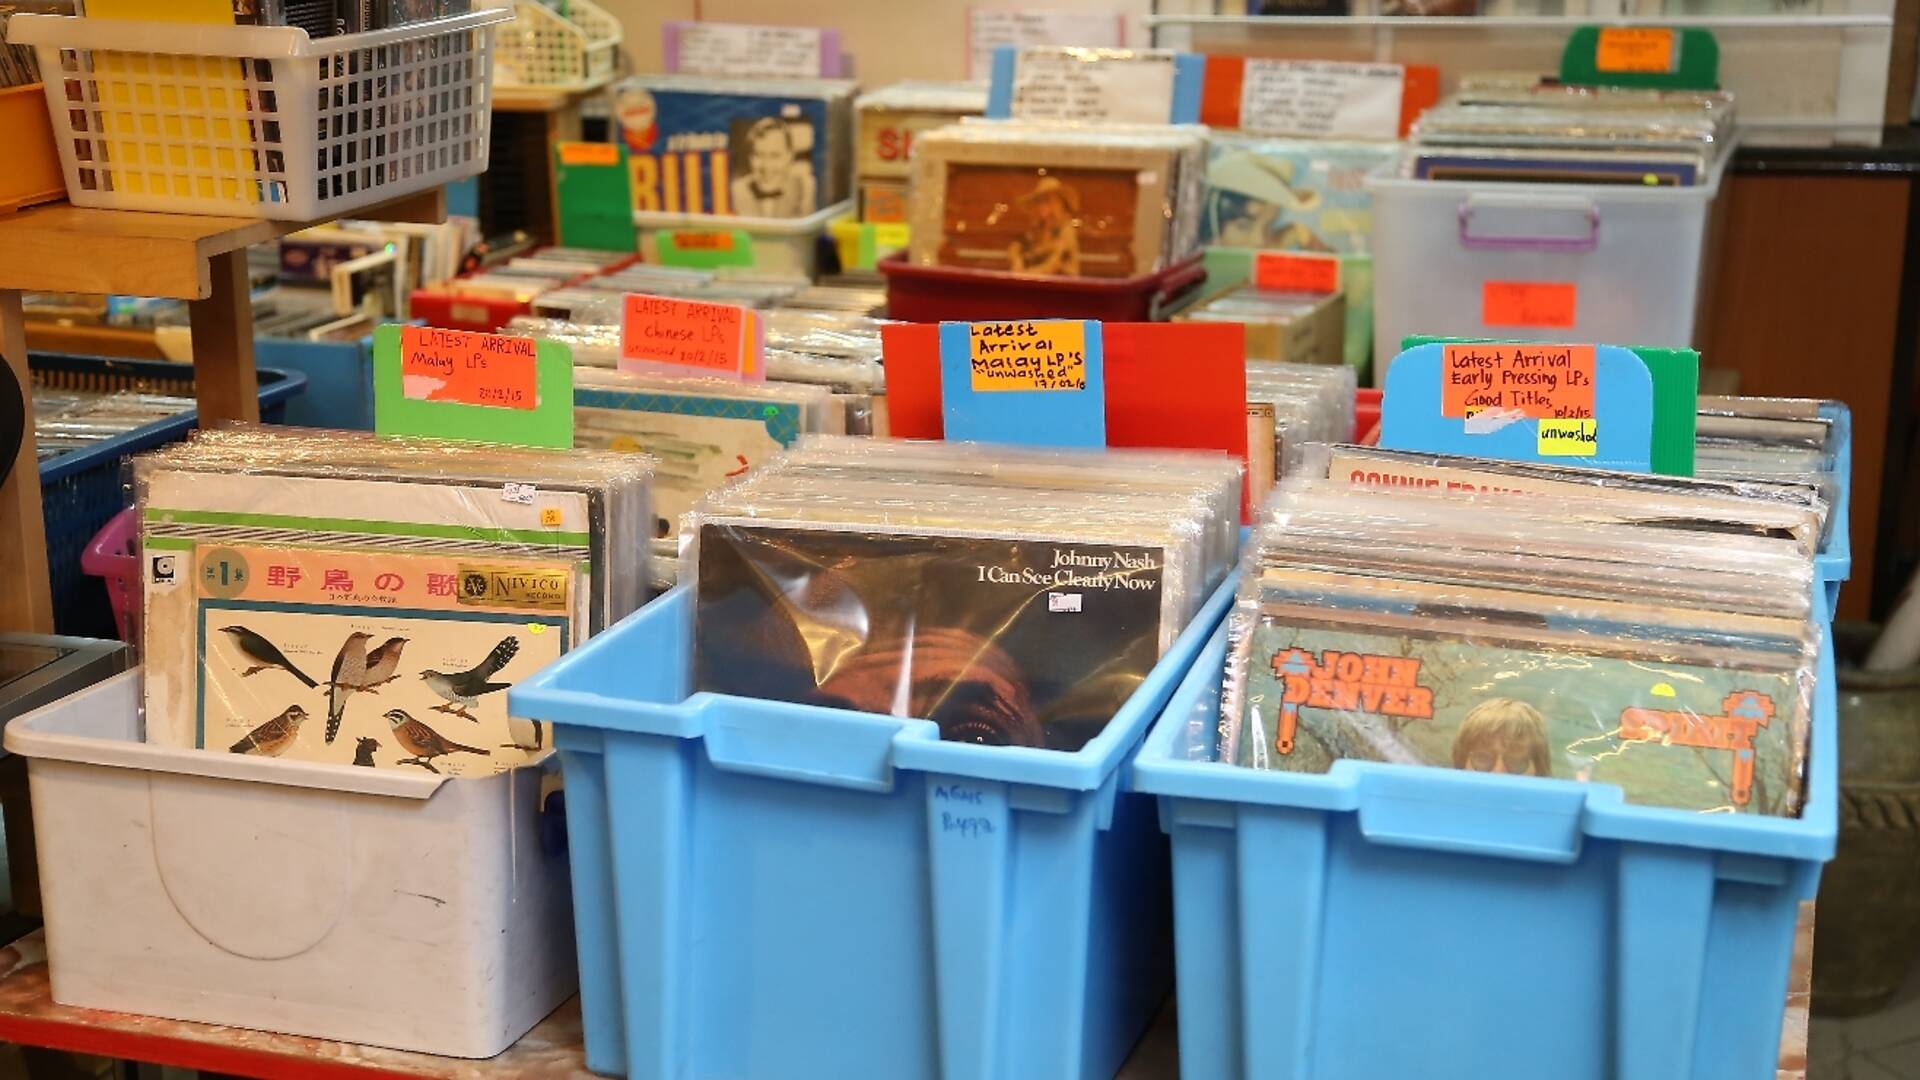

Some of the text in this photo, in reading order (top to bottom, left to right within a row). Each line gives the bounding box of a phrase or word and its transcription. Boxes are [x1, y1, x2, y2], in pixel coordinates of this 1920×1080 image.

[635, 299, 677, 316] LATEST
[971, 322, 1038, 337] Latest
[419, 331, 536, 357] LATEST ARRIVAL
[979, 340, 1053, 355] Arrival
[411, 352, 489, 376] Malay LPs
[1452, 349, 1571, 369] Latest Arrival
[1451, 368, 1590, 392] Early Pressing LPs
[1464, 389, 1553, 409] Good Titles
[1050, 549, 1156, 571] Johnny Nash
[496, 576, 559, 596] NIVICO
[977, 566, 1157, 591] I Can See Clearly Now
[1311, 650, 1423, 689] JOHN
[1282, 675, 1434, 719] DENVER
